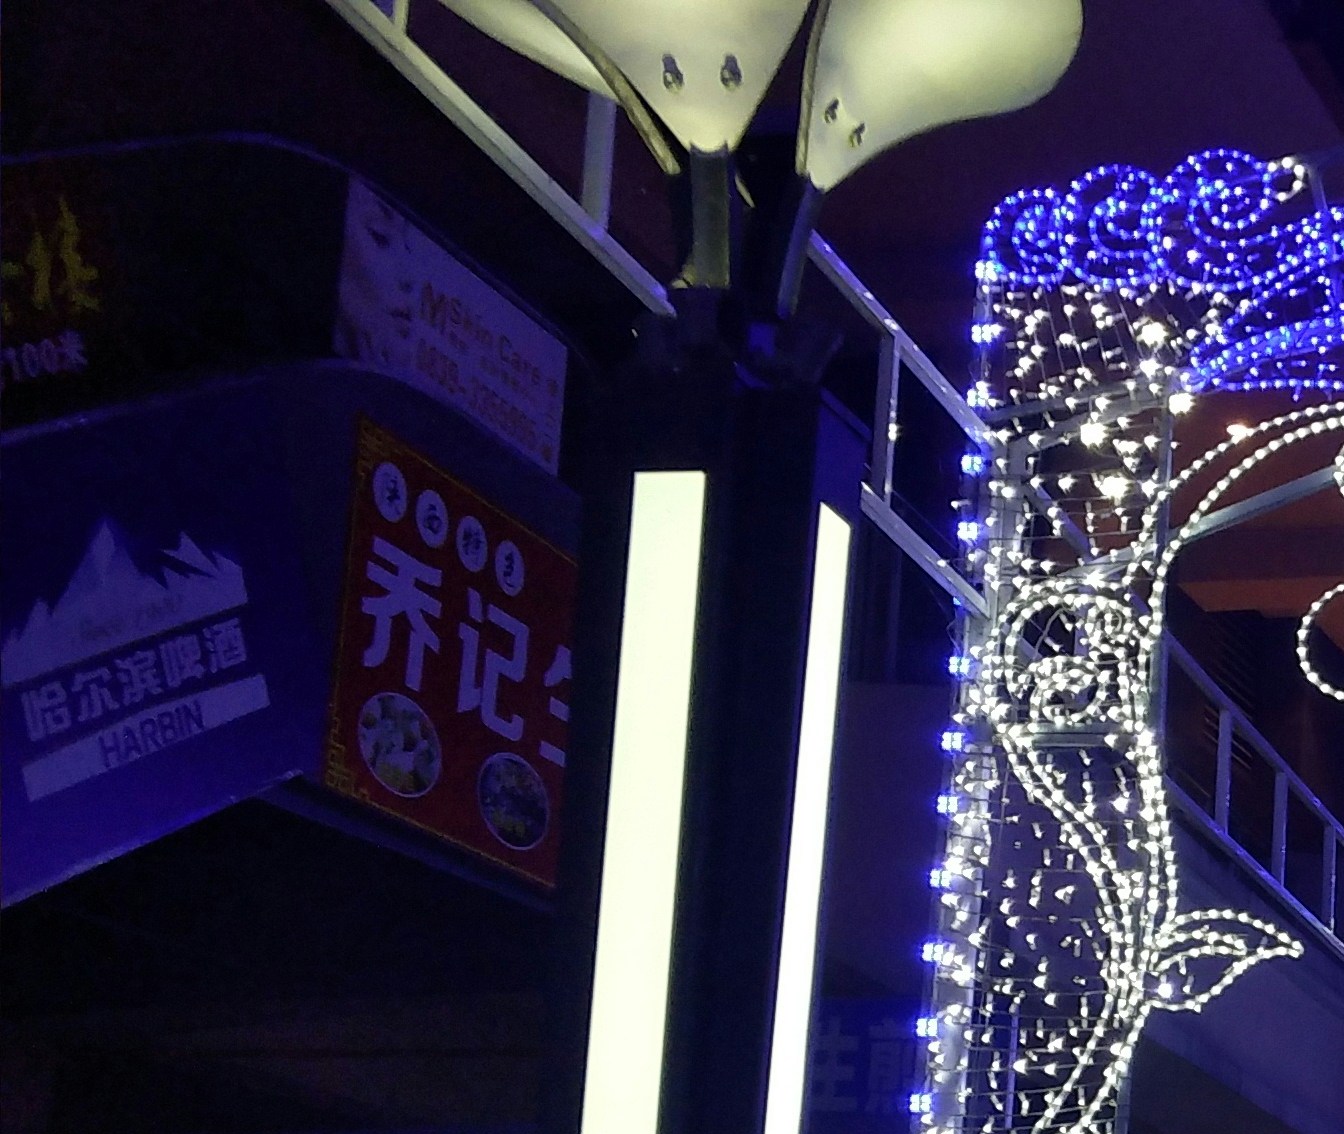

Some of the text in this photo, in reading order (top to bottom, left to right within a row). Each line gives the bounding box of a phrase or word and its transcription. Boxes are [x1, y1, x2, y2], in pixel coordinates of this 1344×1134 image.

[20, 616, 248, 743] 哈尔滨啤酒
[97, 699, 205, 770] HARBIN
